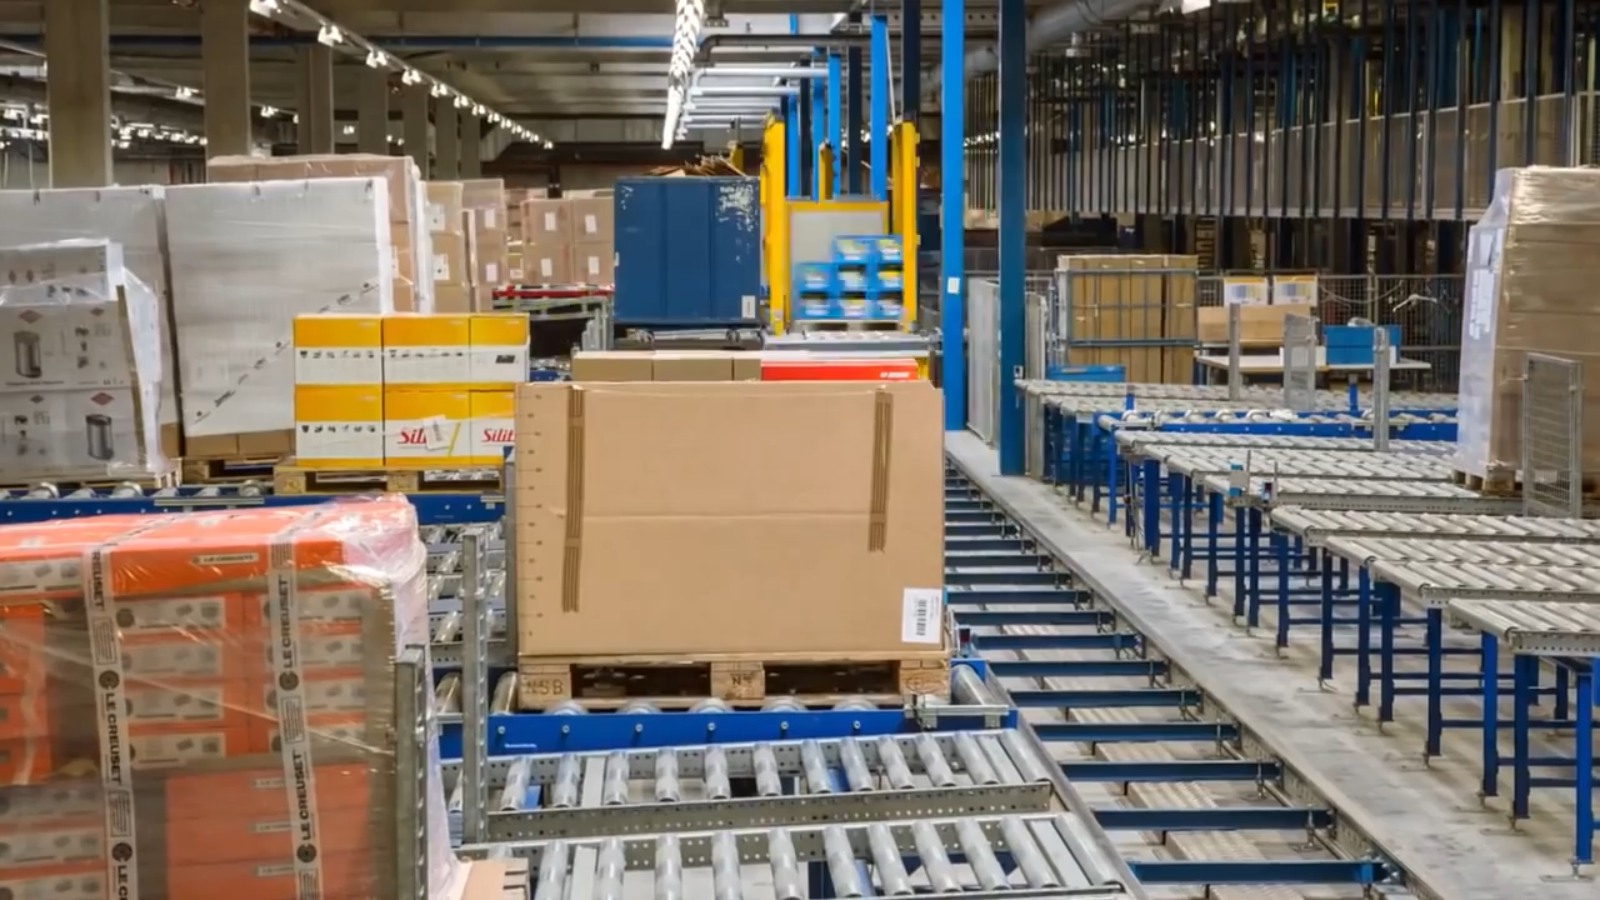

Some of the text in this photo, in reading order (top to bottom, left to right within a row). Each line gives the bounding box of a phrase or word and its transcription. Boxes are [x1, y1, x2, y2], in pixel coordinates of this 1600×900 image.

[397, 428, 427, 444] Sil
[92, 551, 105, 611] REUSET
[278, 574, 291, 648] CREUSET
[282, 649, 293, 669] LE
[106, 692, 117, 712] LE
[107, 713, 122, 786] CREUSET
[293, 748, 311, 840] LE CREUSET
[118, 864, 128, 884] LE
